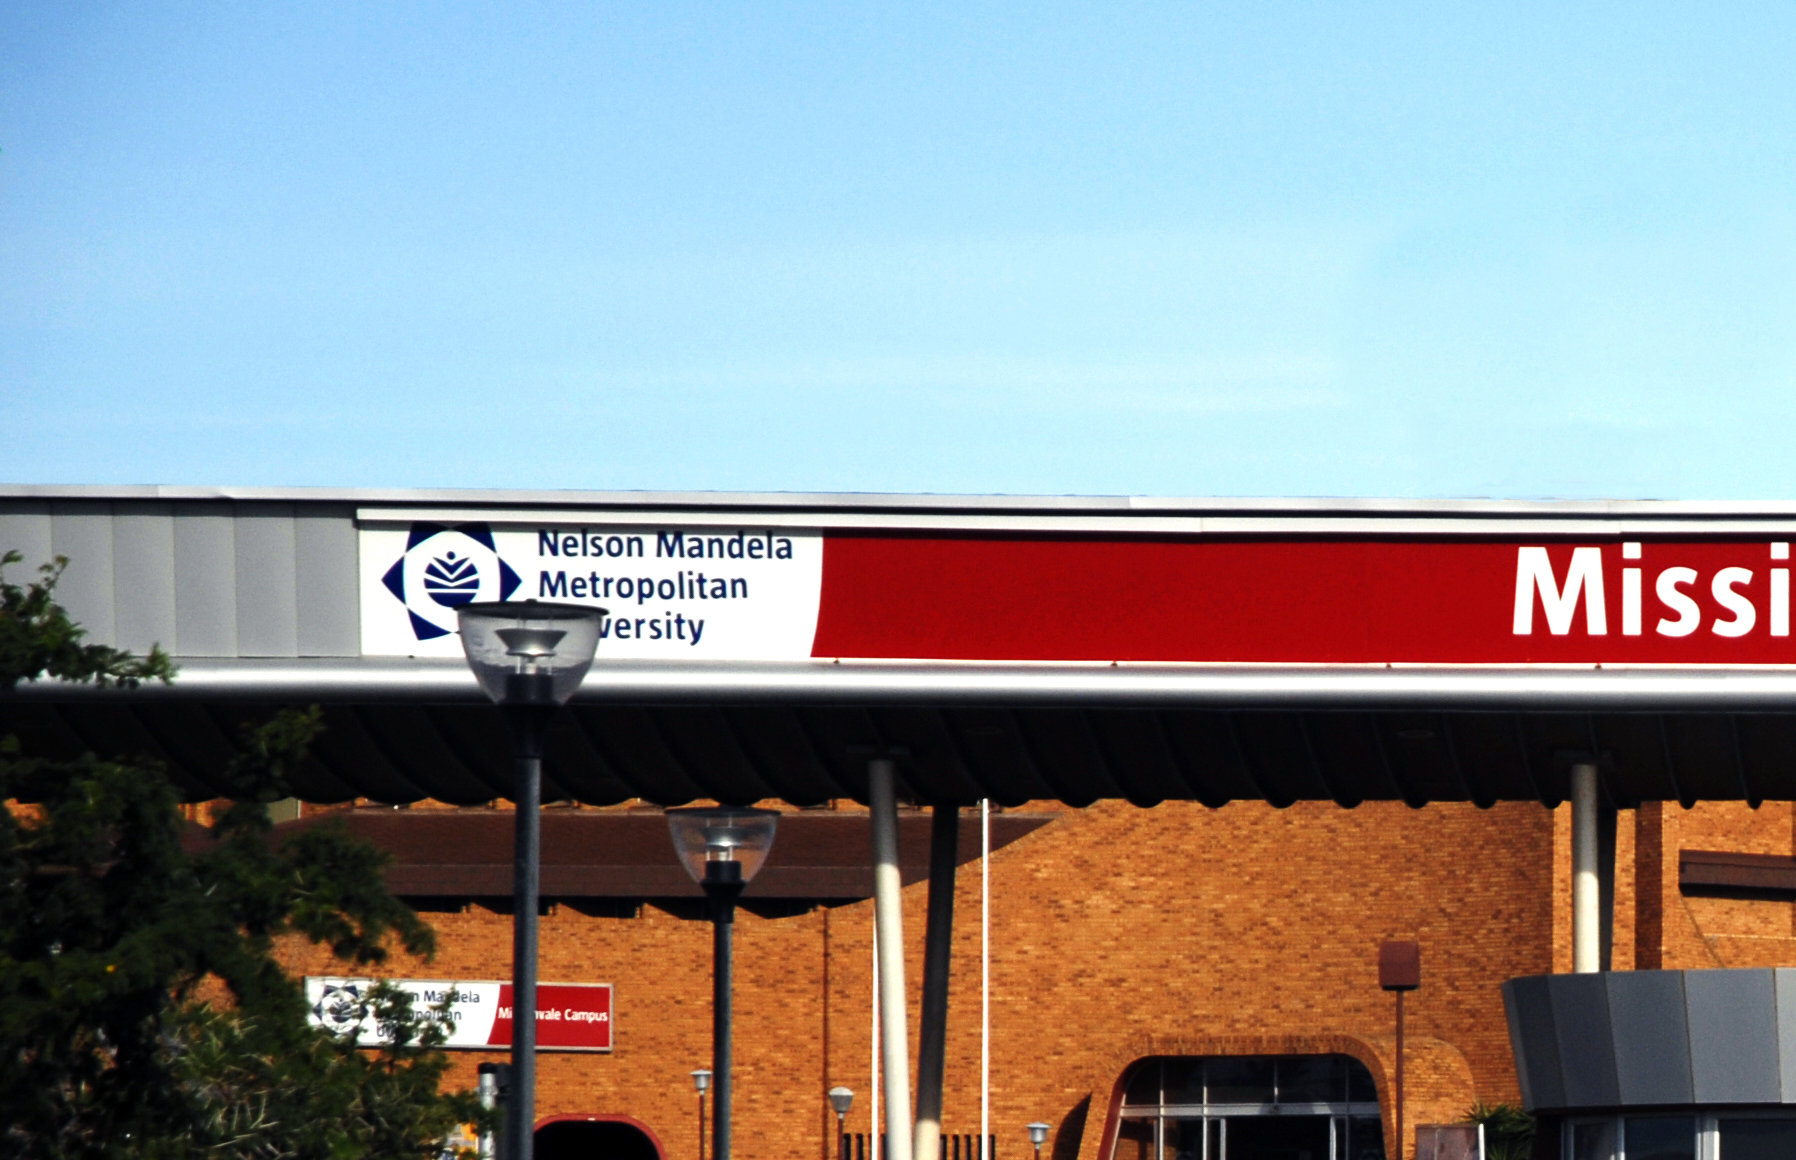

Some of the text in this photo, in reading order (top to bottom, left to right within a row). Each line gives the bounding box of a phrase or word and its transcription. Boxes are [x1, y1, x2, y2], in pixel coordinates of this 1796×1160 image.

[538, 528, 793, 561] Nelson Mandela
[539, 570, 749, 605] Metropolitan
[600, 611, 705, 647] versity
[564, 1008, 608, 1023] Campus
